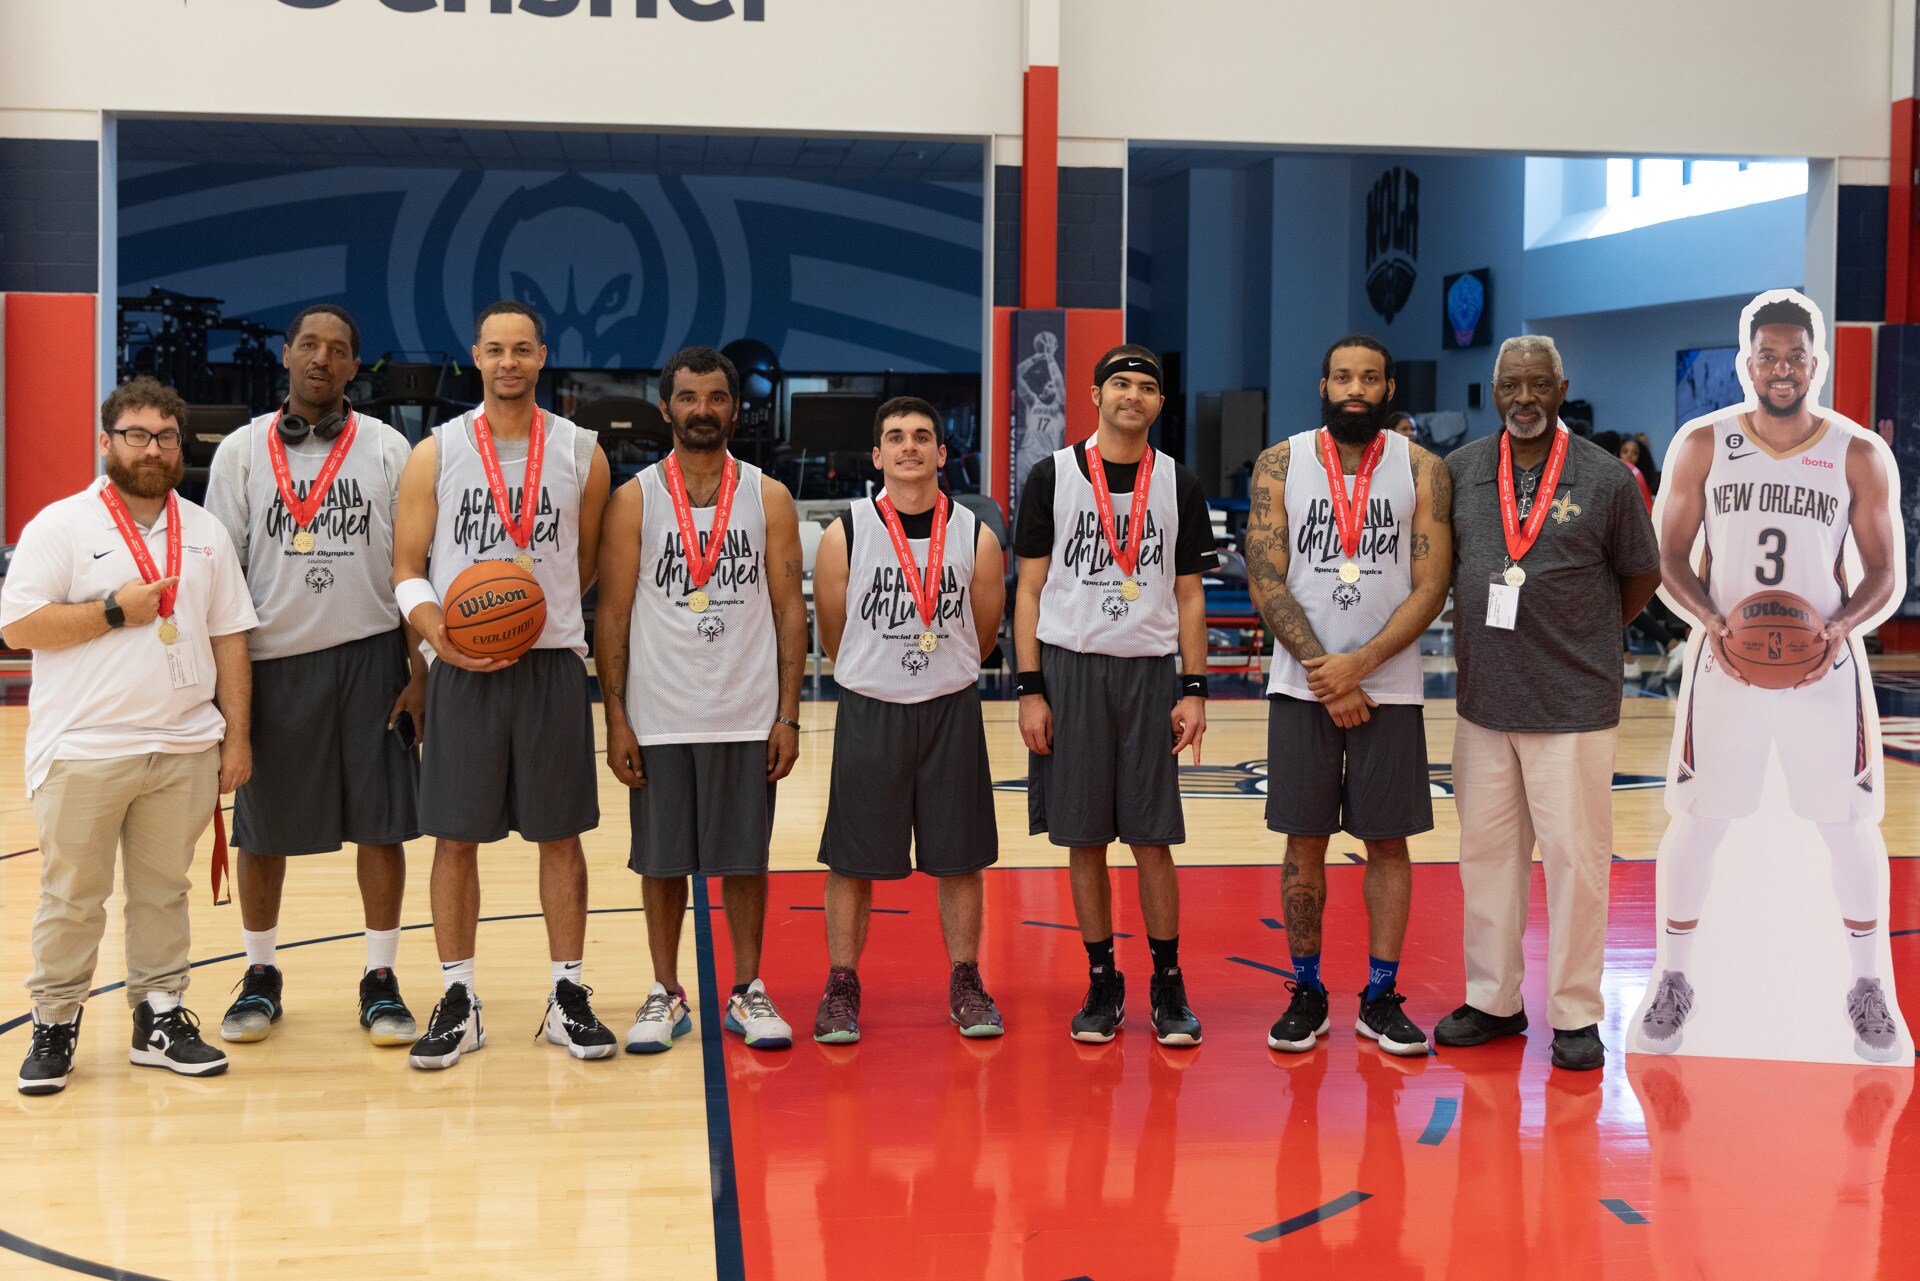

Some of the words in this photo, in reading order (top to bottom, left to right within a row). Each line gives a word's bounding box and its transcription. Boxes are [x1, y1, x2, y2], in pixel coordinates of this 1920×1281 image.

[1037, 417, 1051, 433] 17
[1729, 436, 1740, 447] 6
[1801, 456, 1834, 469] ibotta
[1713, 483, 1754, 516] NEW
[1759, 483, 1839, 526] ORLEANS
[1755, 528, 1787, 586] 3
[458, 588, 528, 618] Wilson
[1742, 601, 1810, 624] Wilson
[472, 616, 534, 644] EVOLUTION
